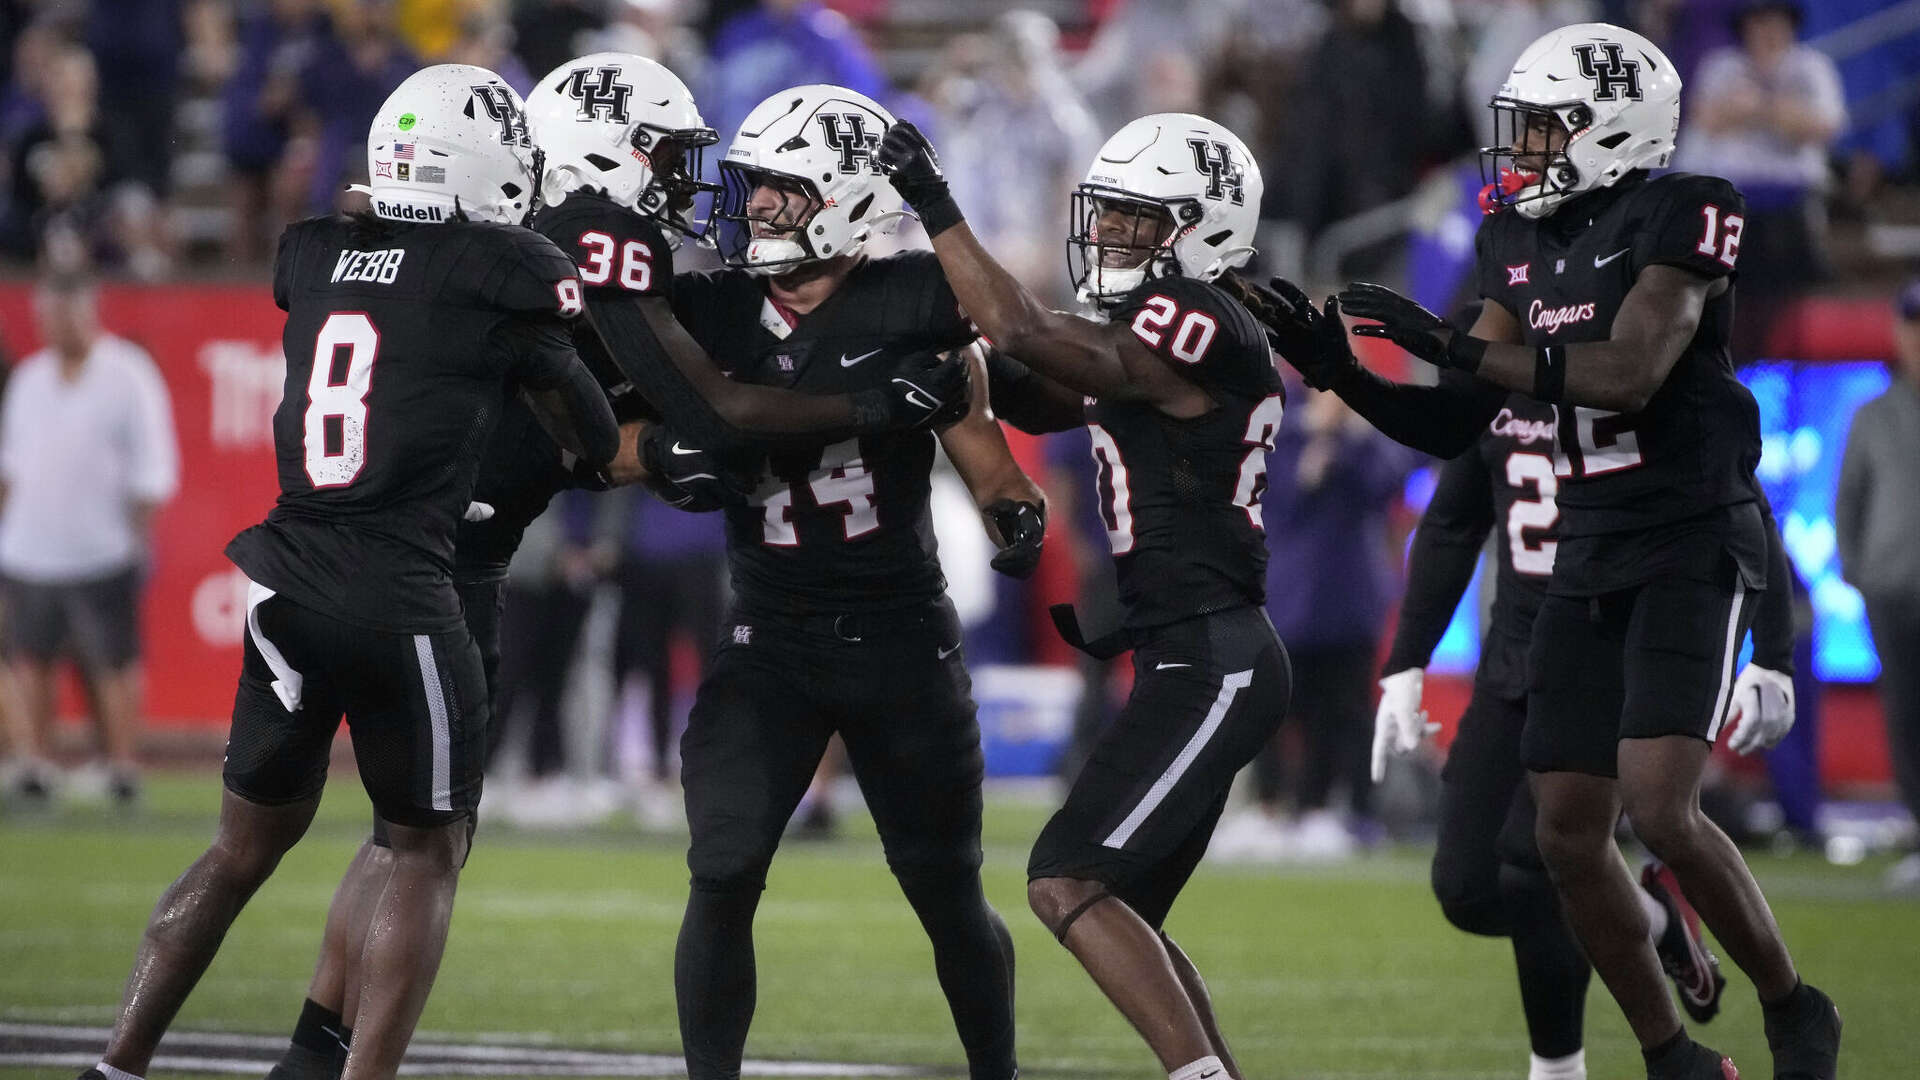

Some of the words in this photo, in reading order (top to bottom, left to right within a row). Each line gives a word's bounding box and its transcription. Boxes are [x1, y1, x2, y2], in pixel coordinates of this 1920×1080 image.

[569, 66, 634, 126] UH
[1571, 43, 1643, 102] UH
[470, 84, 533, 149] UH
[816, 112, 884, 176] UH
[1186, 138, 1245, 207] UH
[377, 200, 442, 222] Riddell
[1698, 203, 1745, 270] 12
[330, 248, 405, 285] WEBB
[578, 229, 653, 292] 36
[1130, 292, 1219, 364] 20
[1528, 298, 1597, 335] Cougars
[303, 310, 381, 489] 8
[1490, 407, 1555, 445] Couga
